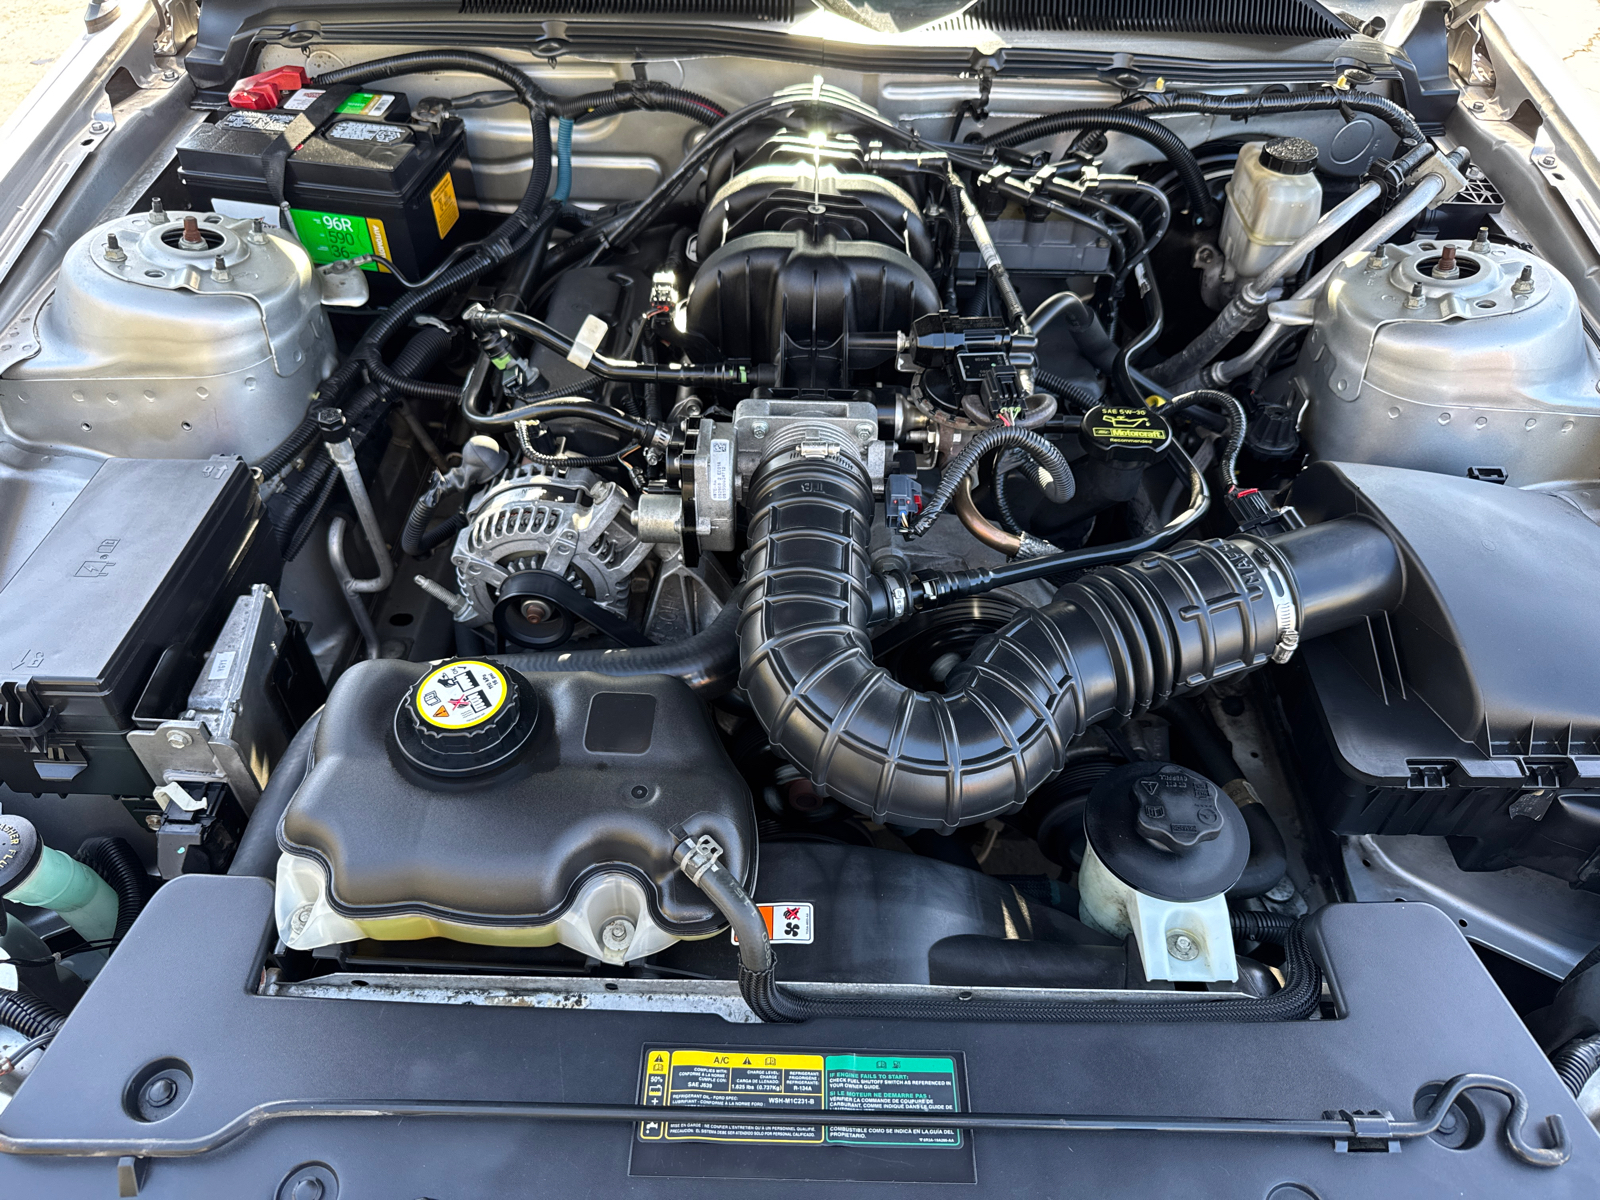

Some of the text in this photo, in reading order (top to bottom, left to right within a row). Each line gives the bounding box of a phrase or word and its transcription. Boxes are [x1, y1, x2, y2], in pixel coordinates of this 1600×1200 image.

[322, 215, 354, 232] 96R
[328, 230, 354, 246] 590
[372, 224, 386, 258] AUTOMOT
[332, 245, 350, 259] 36
[1112, 429, 1160, 438] Motorcraft
[0, 822, 20, 868] ASHER FLU
